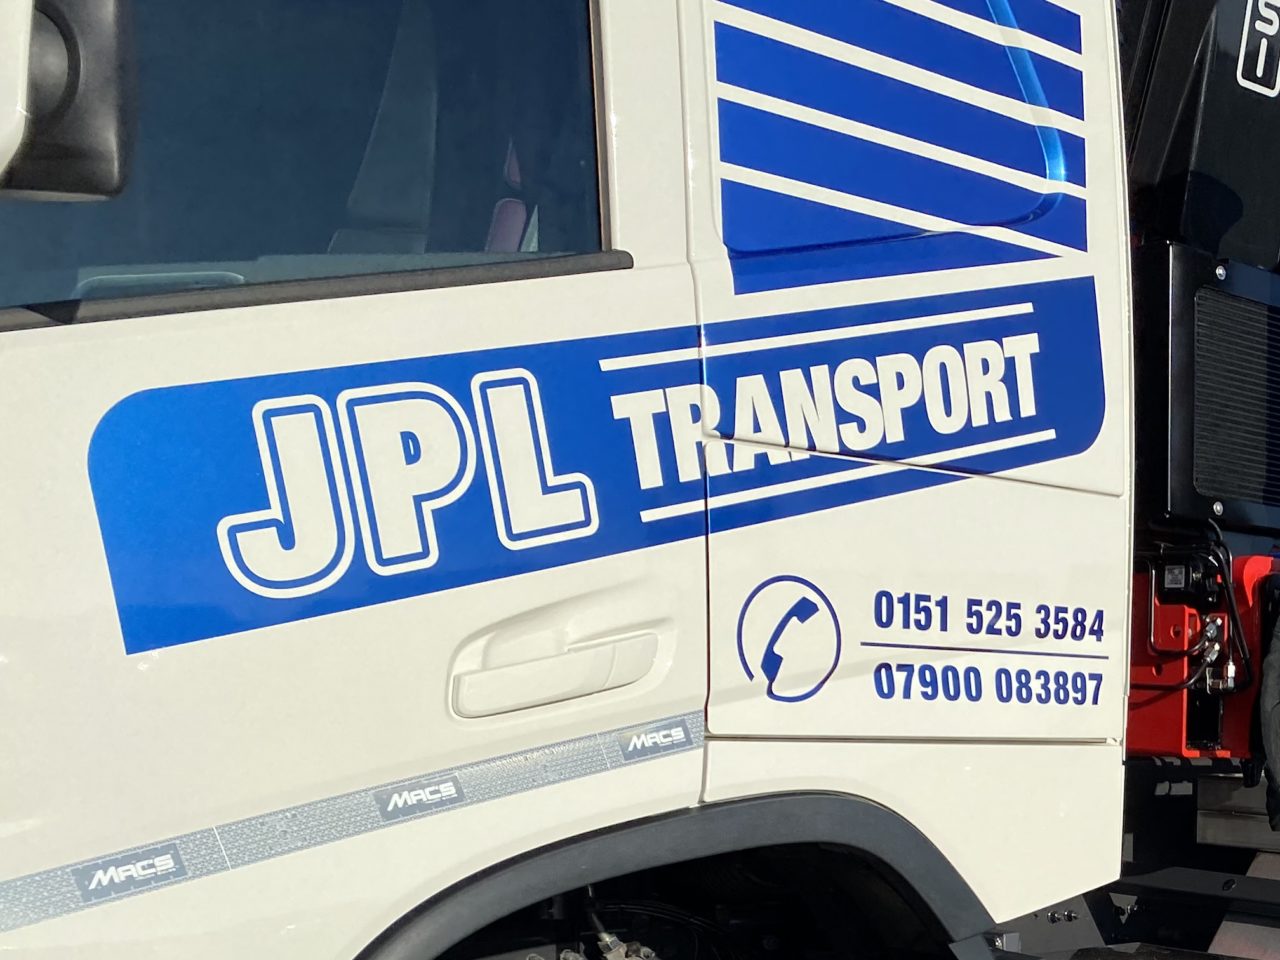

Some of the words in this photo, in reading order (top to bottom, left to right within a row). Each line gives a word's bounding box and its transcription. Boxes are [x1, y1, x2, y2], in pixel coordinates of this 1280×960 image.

[217, 368, 599, 598] JPL
[611, 333, 1040, 490] TRANSPORT
[873, 591, 949, 632] 0151
[966, 598, 1022, 639] 525
[1035, 605, 1104, 643] 3584
[873, 663, 983, 703] 07900
[994, 668, 1104, 706] 083897
[628, 726, 686, 751] MACS
[387, 782, 457, 812] MACS
[88, 854, 175, 890] MACS
